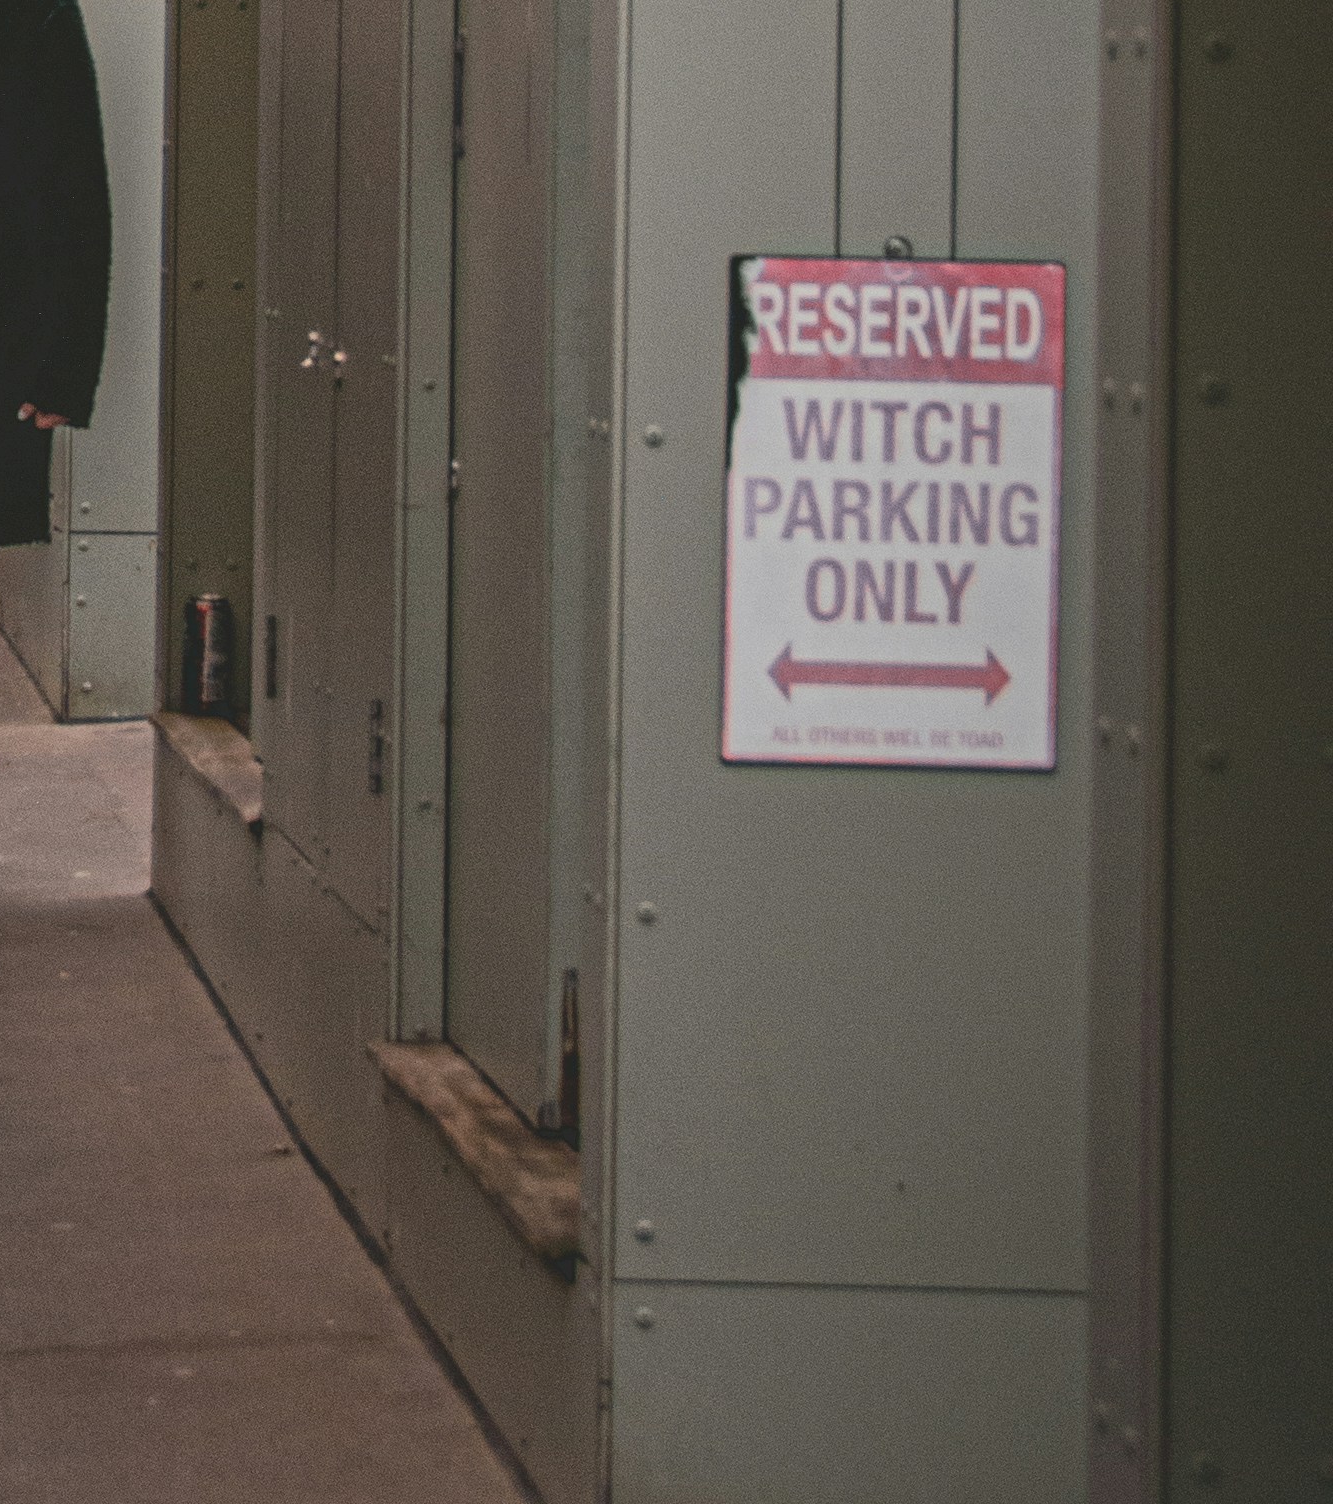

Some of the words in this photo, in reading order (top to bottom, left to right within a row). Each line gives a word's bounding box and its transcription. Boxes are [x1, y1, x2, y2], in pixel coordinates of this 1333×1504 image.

[750, 282, 1044, 361] RESERVED
[783, 397, 1003, 465] WITCH
[744, 477, 1040, 547] PARKING
[804, 558, 976, 624] ONLY
